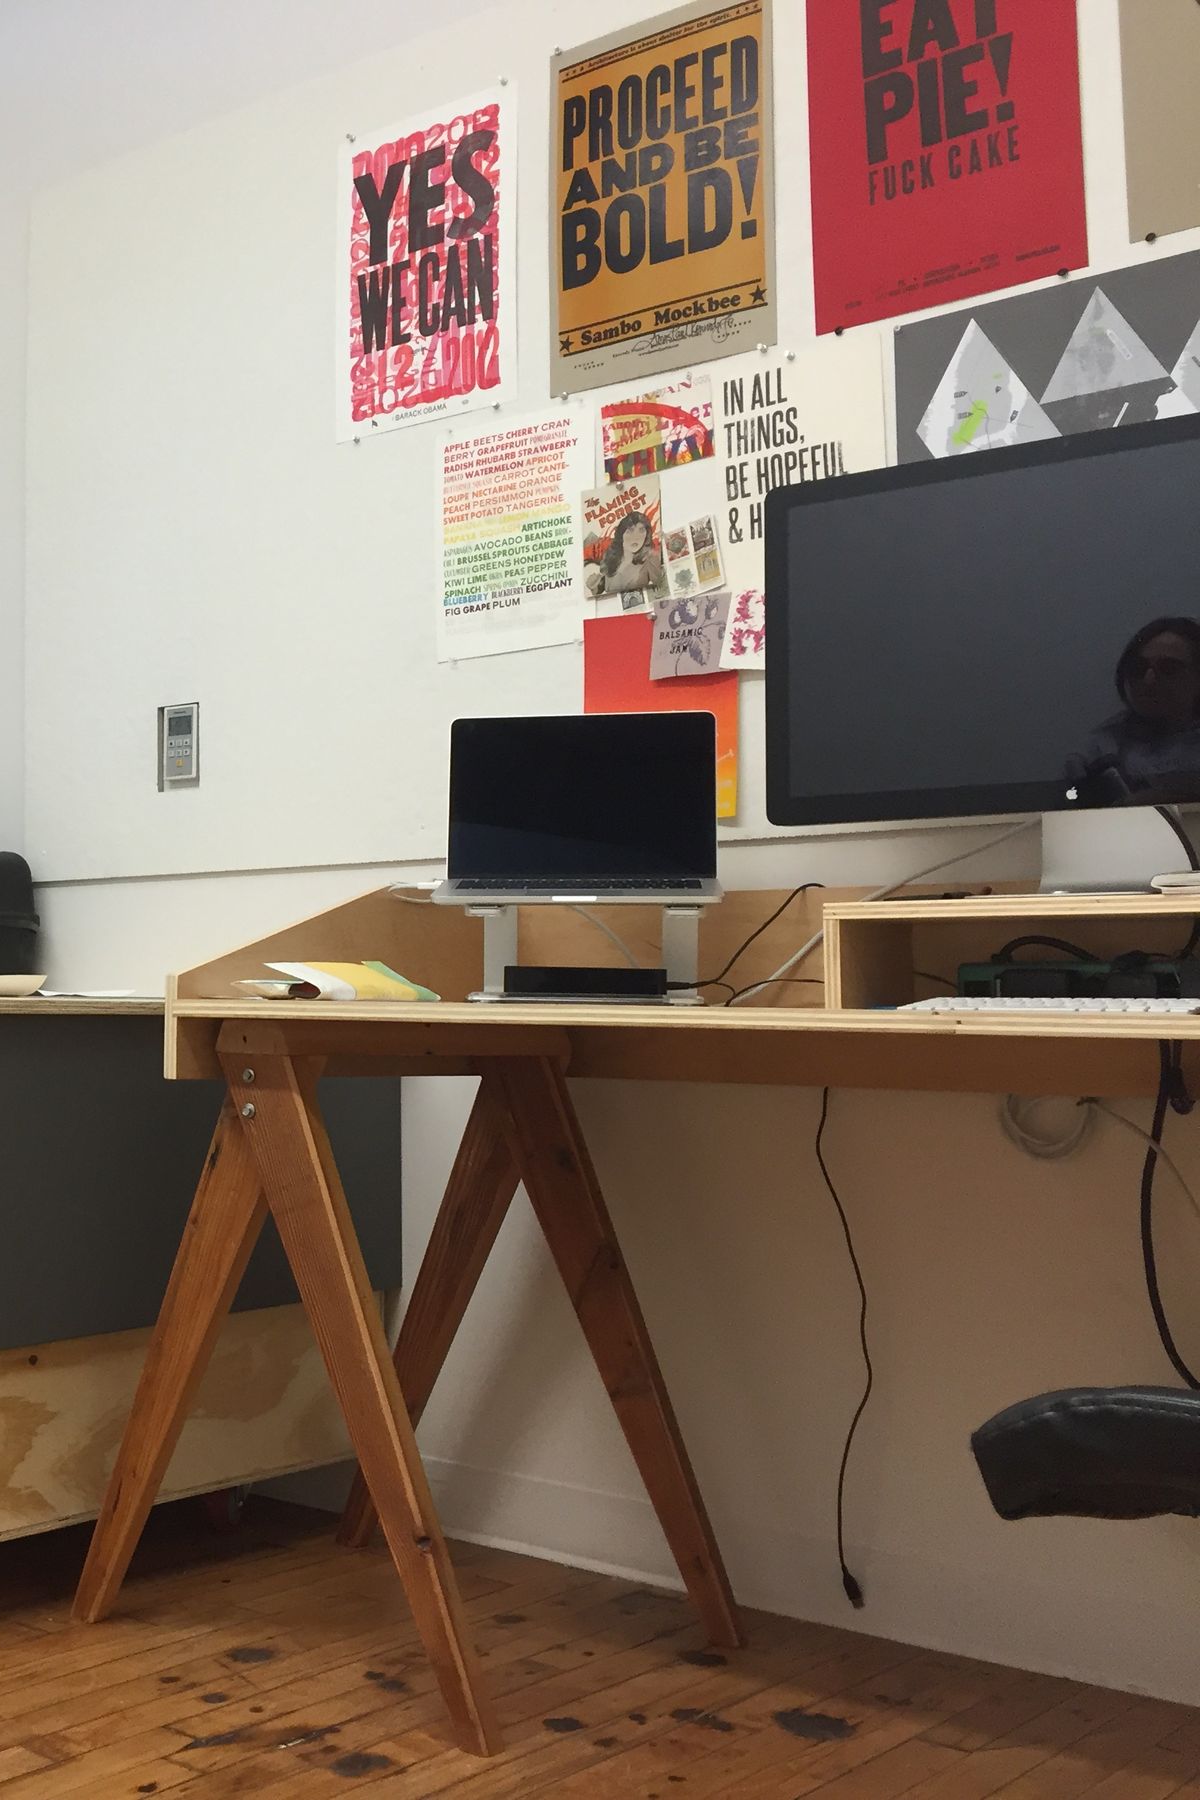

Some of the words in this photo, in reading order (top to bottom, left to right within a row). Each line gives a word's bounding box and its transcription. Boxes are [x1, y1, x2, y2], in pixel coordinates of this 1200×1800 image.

[563, 35, 759, 172] PROCEED
[863, 32, 1014, 165] PIE!
[562, 147, 675, 211] AND
[683, 113, 760, 172] BE
[868, 152, 935, 206] FUCK
[947, 124, 1021, 181] CAKE
[353, 130, 497, 266] YES
[562, 154, 759, 291] BOLD!
[357, 260, 411, 355] WE
[418, 233, 494, 338] CAN
[580, 318, 642, 346] Sambo
[653, 294, 741, 327] Mockbee
[723, 377, 744, 417] IN
[751, 367, 788, 411] ALL
[395, 409, 422, 422] BARACK
[423, 403, 447, 416] OBAMA
[444, 441, 470, 454] APPLE
[473, 434, 504, 446] BEETS
[506, 426, 539, 439] CHERRY
[724, 406, 805, 459] THINGS,
[444, 461, 473, 474] RADISH
[476, 452, 516, 467] RHUBARB
[518, 438, 578, 457] STRAWBERRY
[445, 450, 475, 464] BERRY
[477, 438, 528, 457] GRAPEFRUIT
[465, 460, 524, 479] WATERMELON
[526, 451, 565, 466] APRICOT
[494, 468, 536, 483] CARROT
[538, 462, 569, 474] CANTE-
[725, 461, 752, 502] BE
[756, 440, 849, 496] HOPEFUL
[444, 492, 469, 505] LOUPE
[472, 482, 517, 499] NECTARINE
[519, 472, 562, 489] ORANGE
[444, 502, 470, 515] PEACH
[473, 489, 533, 508] PERSIMMON
[584, 496, 600, 509] The
[584, 485, 640, 523] FLAMING
[444, 513, 469, 526] SWEET
[471, 506, 504, 519] POTATO
[506, 493, 565, 512] TANGERINE
[521, 516, 572, 532] ARTICHOKE
[598, 493, 648, 529] FOREST
[474, 536, 523, 552] AVOCADO
[525, 530, 553, 542] BEANS
[728, 507, 744, 544] &
[457, 554, 491, 566] BRUSSEL
[492, 545, 530, 559] SPROUTS
[532, 537, 574, 552] CABBAGE
[472, 559, 512, 573] GREENS
[513, 550, 565, 566] HONEYDEW
[444, 578, 465, 588] KIWI
[467, 574, 487, 585] LIME
[504, 568, 525, 578] PEAS
[527, 560, 567, 574] PEPPER
[444, 586, 481, 599] SPINACH
[520, 570, 569, 586] ZUCCHINI
[444, 593, 489, 607] BLUEBERRY
[526, 578, 573, 593] EGGPLANT
[445, 607, 461, 616] FIG
[463, 603, 490, 614] GRAPE
[492, 598, 521, 609] PLUM
[659, 626, 704, 640] BALSAMIC
[669, 645, 689, 655] JAM
